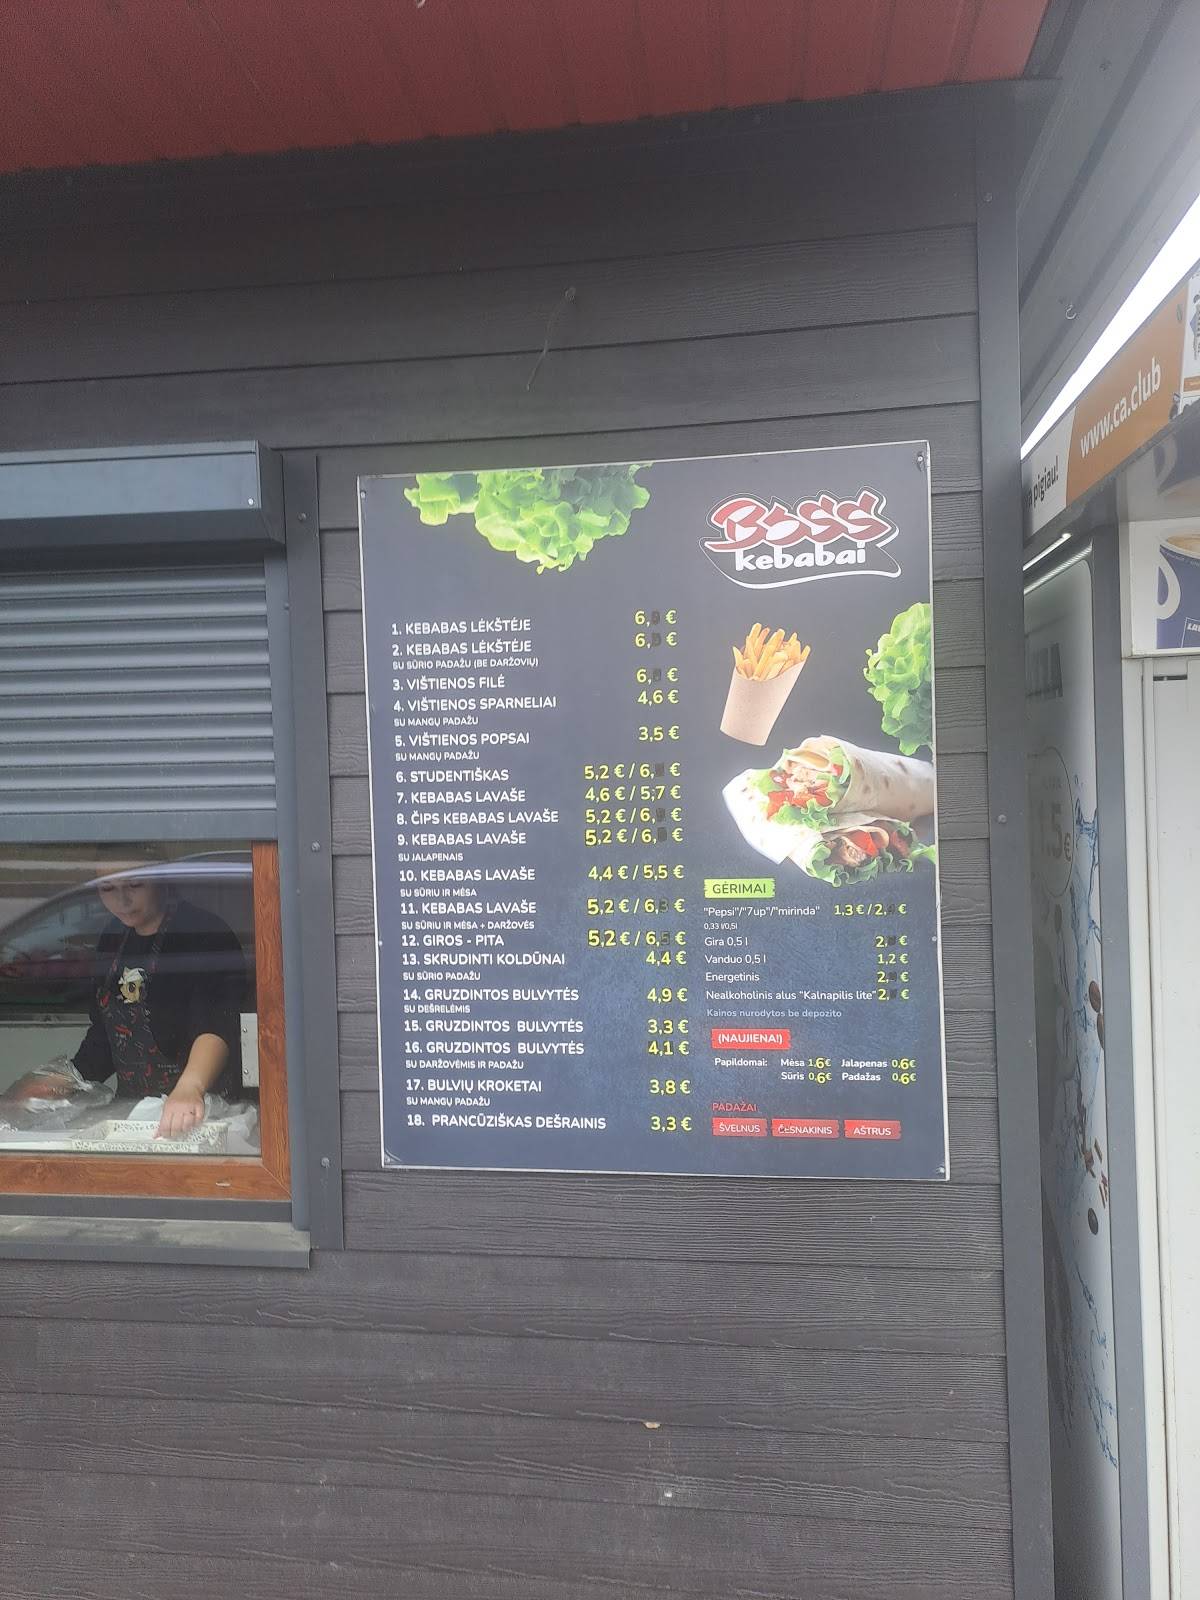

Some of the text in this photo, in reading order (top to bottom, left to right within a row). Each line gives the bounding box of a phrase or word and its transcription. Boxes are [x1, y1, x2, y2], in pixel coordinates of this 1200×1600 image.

[1079, 357, 1161, 459] www.ca.club
[1033, 455, 1059, 508] pigiau!
[735, 541, 866, 571] kebabai
[392, 618, 531, 635] 1. KEBABAS LĖKŠTĖJE
[392, 639, 531, 657] 2. KEBABAS LĖKŠTĖJE
[393, 657, 538, 670] SU SŪRIO PADAŽU (BE DARŽOVIŲ)
[393, 676, 505, 691] 3. VIŠTIENOS FILĖ
[394, 696, 556, 712] 4. VIŠTIENOS SPARNELIAI
[638, 690, 663, 707] 4,6
[394, 715, 478, 727] SU MANGŲ PADAŽU
[395, 732, 529, 747] 5. VIŠTIENOS POPSAI
[639, 727, 664, 743] 3,5
[396, 750, 479, 762] SU MANGŲ PADAŽU
[396, 768, 509, 783] 6. STUDENTIŠKAS
[584, 765, 609, 781] 5,2
[397, 790, 525, 804] 7. KEBABAS LAVAŠE
[585, 787, 610, 803] 4,6
[397, 810, 559, 825] 8. ČIPS KEBABAS LAVAŠE
[586, 809, 611, 826] 5,2
[398, 832, 526, 846] 9. KEBABAS LAVAŠE
[585, 830, 612, 846] 5,2
[398, 852, 463, 862] SU JALAPENAIS
[400, 867, 535, 881] 10. KEBABAS LAVAŠE
[588, 865, 668, 881] 4,4 5,5
[401, 887, 477, 897] SU SŪRIU IR MĖSA
[712, 882, 766, 894] GĖRIMAI
[401, 900, 536, 914] 11. KEBABAS LAVAŠE
[587, 899, 614, 915] 5,2
[834, 905, 853, 916] 1,3
[402, 919, 534, 929] SU SŪRIU IR MĖSA DARŽOVĖS
[402, 934, 504, 946] 12. GIROS PITA
[588, 930, 616, 947] 5,2
[705, 937, 724, 946] Gira
[727, 937, 742, 947] 0,5
[402, 951, 565, 965] 13. SKRUDINTI KOLDŪNAI
[646, 951, 671, 967] 4,4
[705, 955, 742, 964] Vanduo
[745, 955, 760, 965] 0,5
[878, 954, 896, 965] 1,2
[403, 970, 480, 981] SU SŪRIO PADAŽU
[706, 972, 760, 983] Energetinis
[403, 987, 579, 1001] 14. GRUZDINTOS BULVYTĖS
[647, 989, 672, 1004] 4,9
[706, 991, 772, 1001] Nealkoholinis
[776, 991, 796, 1000] alus
[404, 1003, 470, 1014] SU DEŠRELĖMIS
[707, 1009, 841, 1019] Kainos nurodytos be depozito
[404, 1019, 583, 1032] 15. GRUZDINTOS BULVYTĖS
[648, 1020, 673, 1036] 3,3
[718, 1033, 783, 1044] (NAUJIENA!)
[405, 1041, 584, 1054] 16. GRUZDINTOS BULVYTĖS
[648, 1041, 673, 1058] 4,1
[406, 1059, 524, 1069] SU DARŽOVĖMIS IR PADAŽU
[715, 1058, 767, 1068] Papildomai:
[781, 1058, 804, 1067] Mėsa
[841, 1059, 887, 1069] Jalapenas
[781, 1072, 804, 1080] Sūris
[842, 1072, 880, 1081] Padažas
[406, 1079, 542, 1093] 17. BULVIŲ KROKETAI
[649, 1079, 676, 1096] 3,8
[407, 1095, 490, 1107] SU MANGŲ PADAŽU
[407, 1113, 606, 1129] 18. PRANCŪZIŠKAS DEŠRAINIS
[650, 1117, 677, 1133] 3,3
[720, 1122, 760, 1132] ŠVELNUS
[854, 1124, 891, 1136] AŠTRUS
